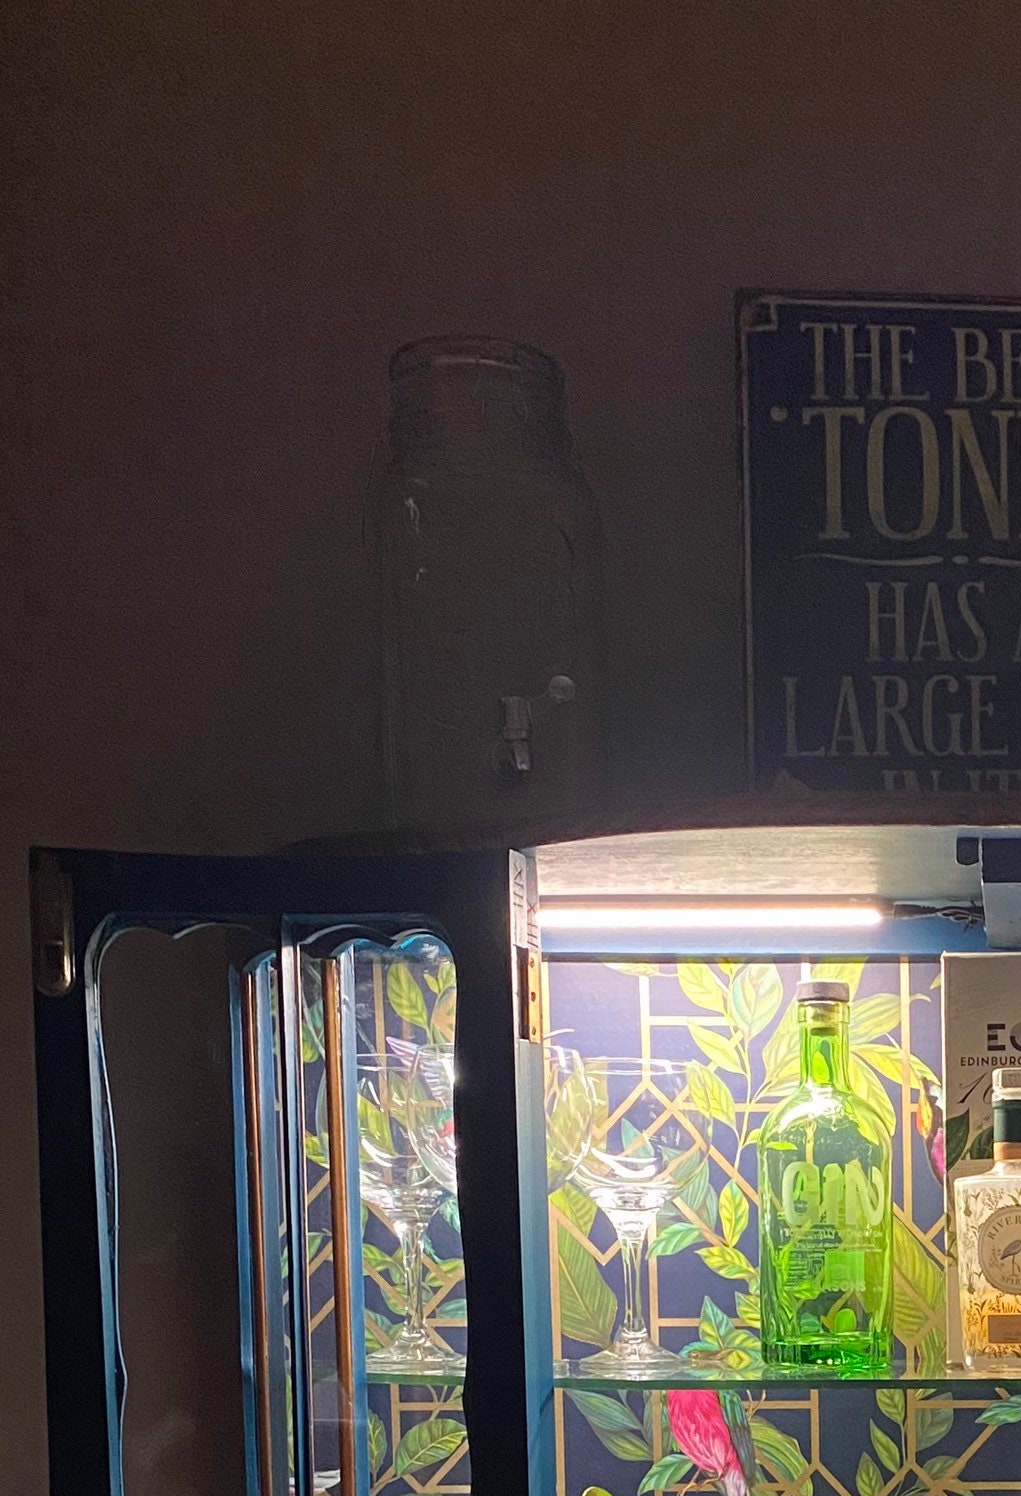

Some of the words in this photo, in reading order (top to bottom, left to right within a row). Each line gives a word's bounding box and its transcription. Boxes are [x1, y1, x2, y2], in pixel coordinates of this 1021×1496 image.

[800, 321, 929, 402] THE
[865, 580, 986, 663] HAS
[783, 673, 1009, 758] LARGE
[782, 1160, 884, 1227] GIN
